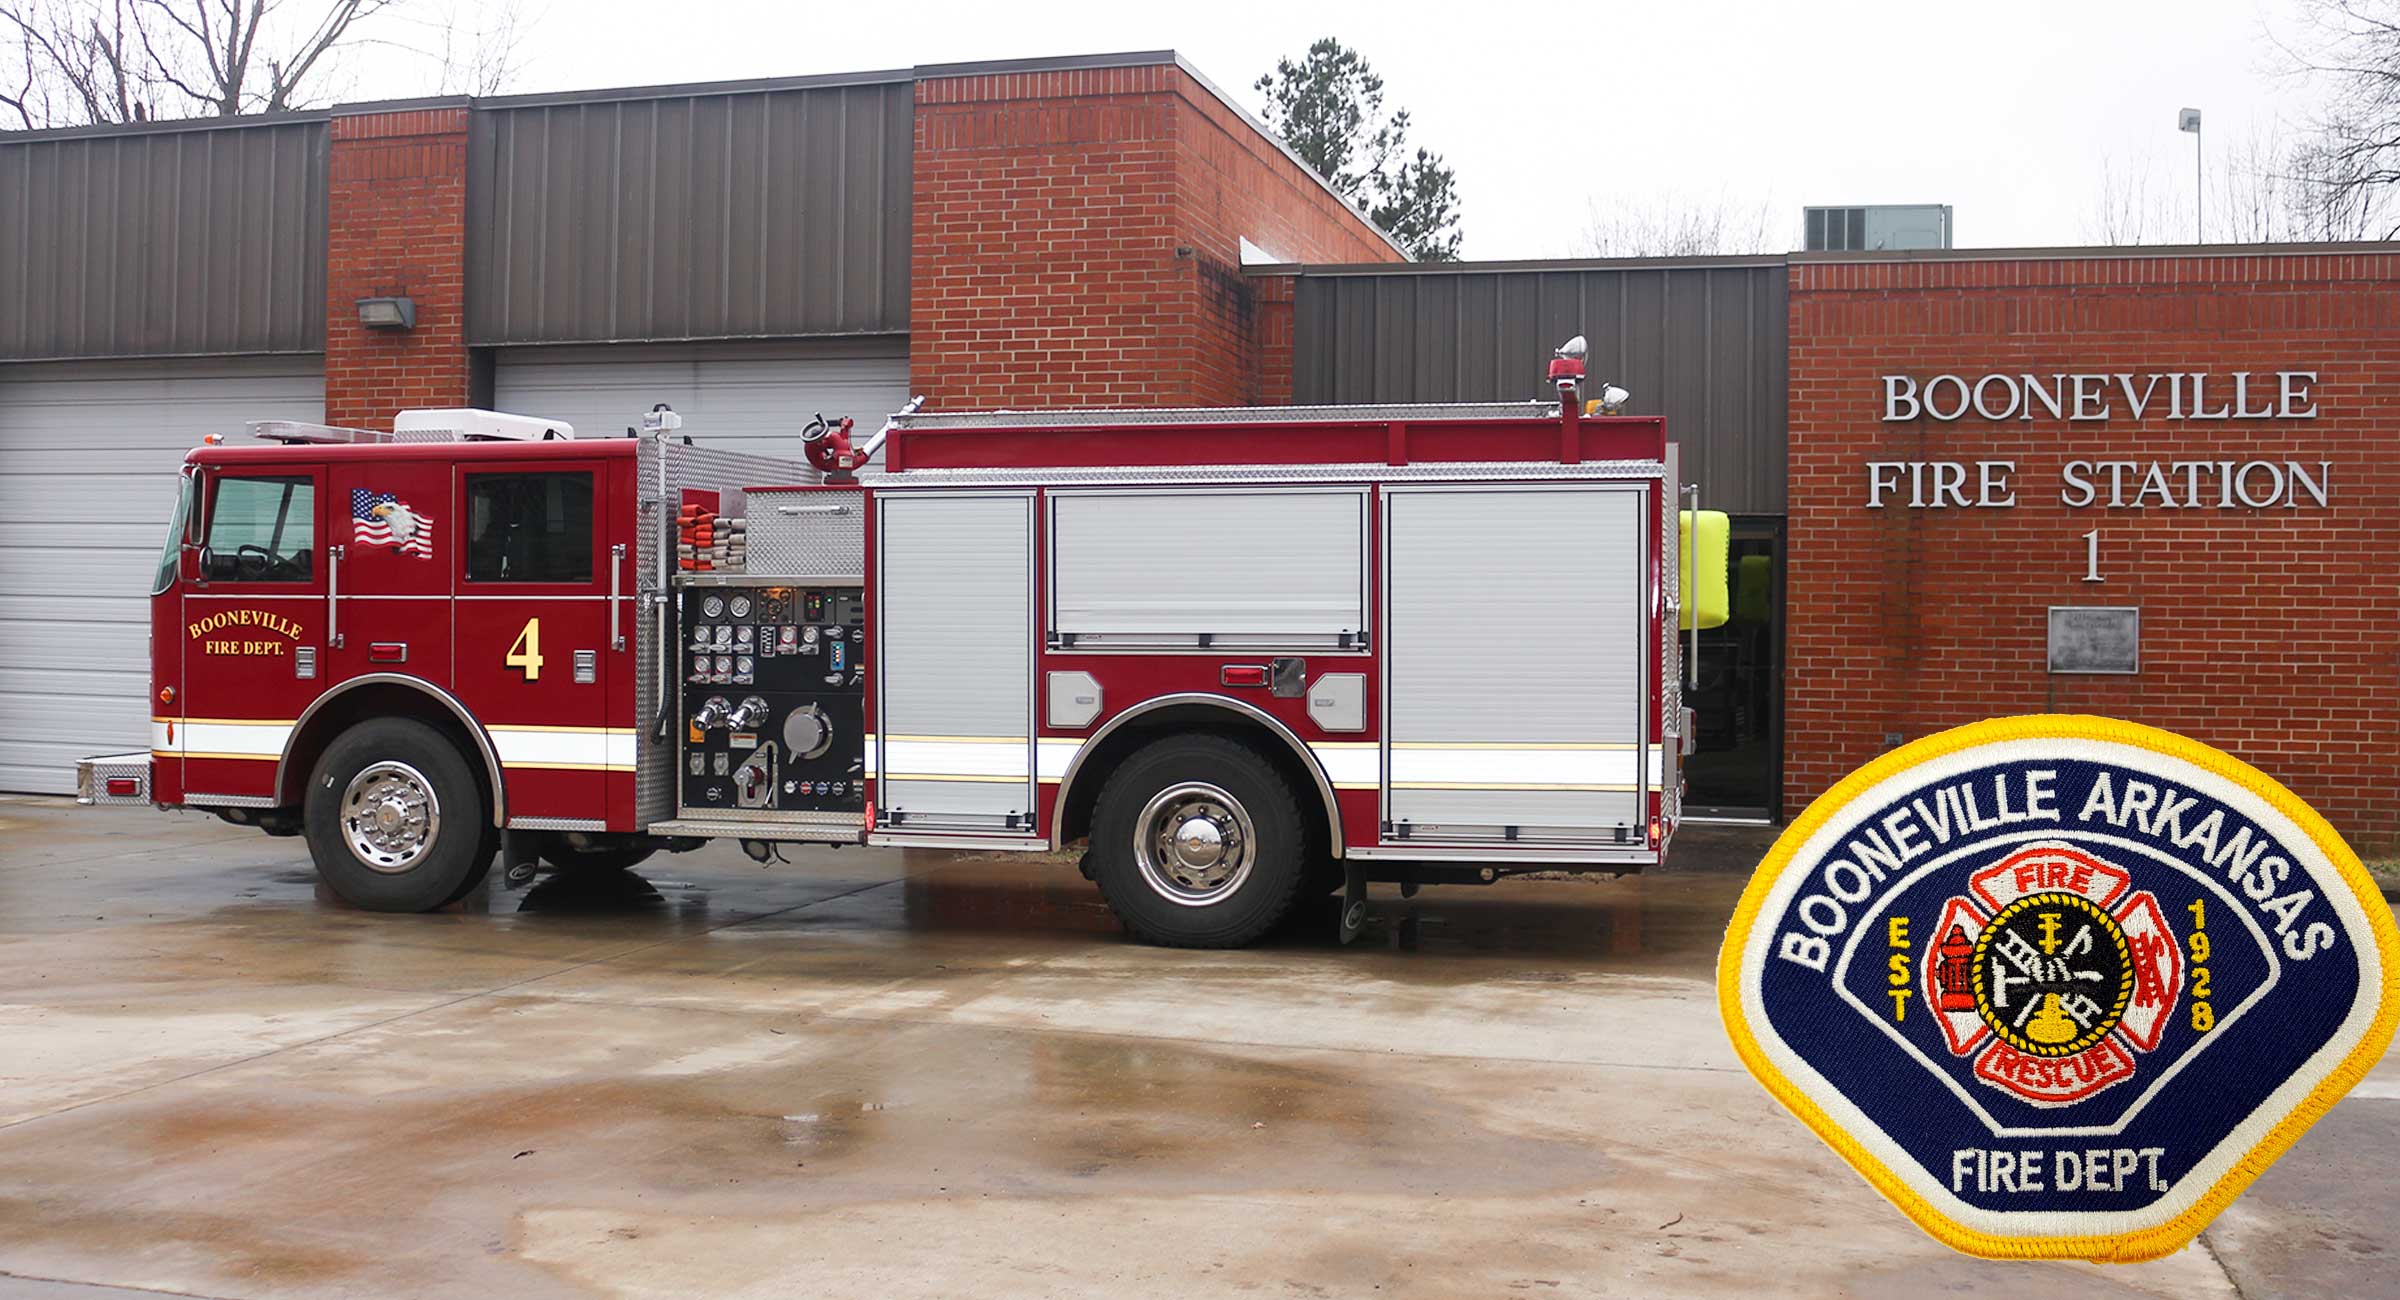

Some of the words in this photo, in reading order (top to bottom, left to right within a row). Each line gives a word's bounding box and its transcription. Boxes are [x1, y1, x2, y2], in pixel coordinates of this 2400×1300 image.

[1881, 371, 2318, 422] BOONEVILLE
[1865, 461, 2017, 508] FIRE
[2061, 460, 2333, 508] STATION
[2081, 528, 2105, 582] 1
[188, 609, 303, 641] BOONEVILLE
[205, 640, 240, 655] FIRE
[243, 640, 285, 656] DEPT.
[505, 617, 544, 681] 4
